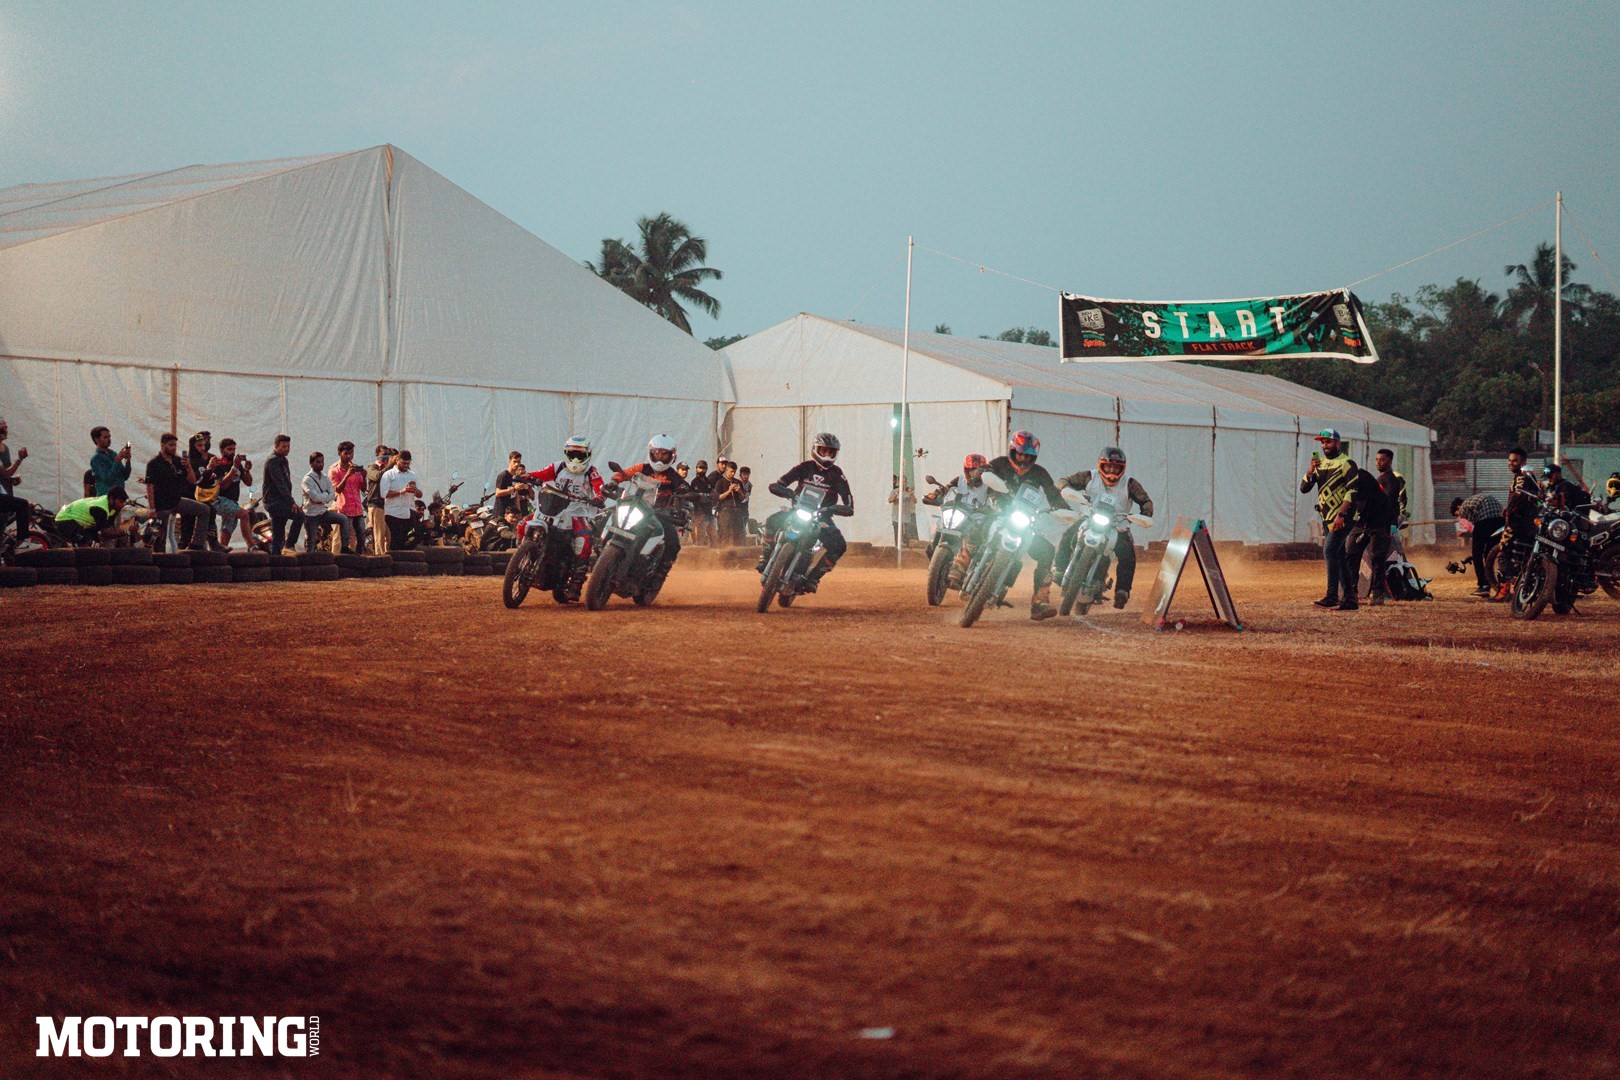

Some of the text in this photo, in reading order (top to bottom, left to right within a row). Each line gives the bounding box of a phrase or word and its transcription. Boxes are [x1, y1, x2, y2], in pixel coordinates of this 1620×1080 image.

[1142, 307, 1286, 339] START
[1191, 341, 1256, 352] FLAT TRACK
